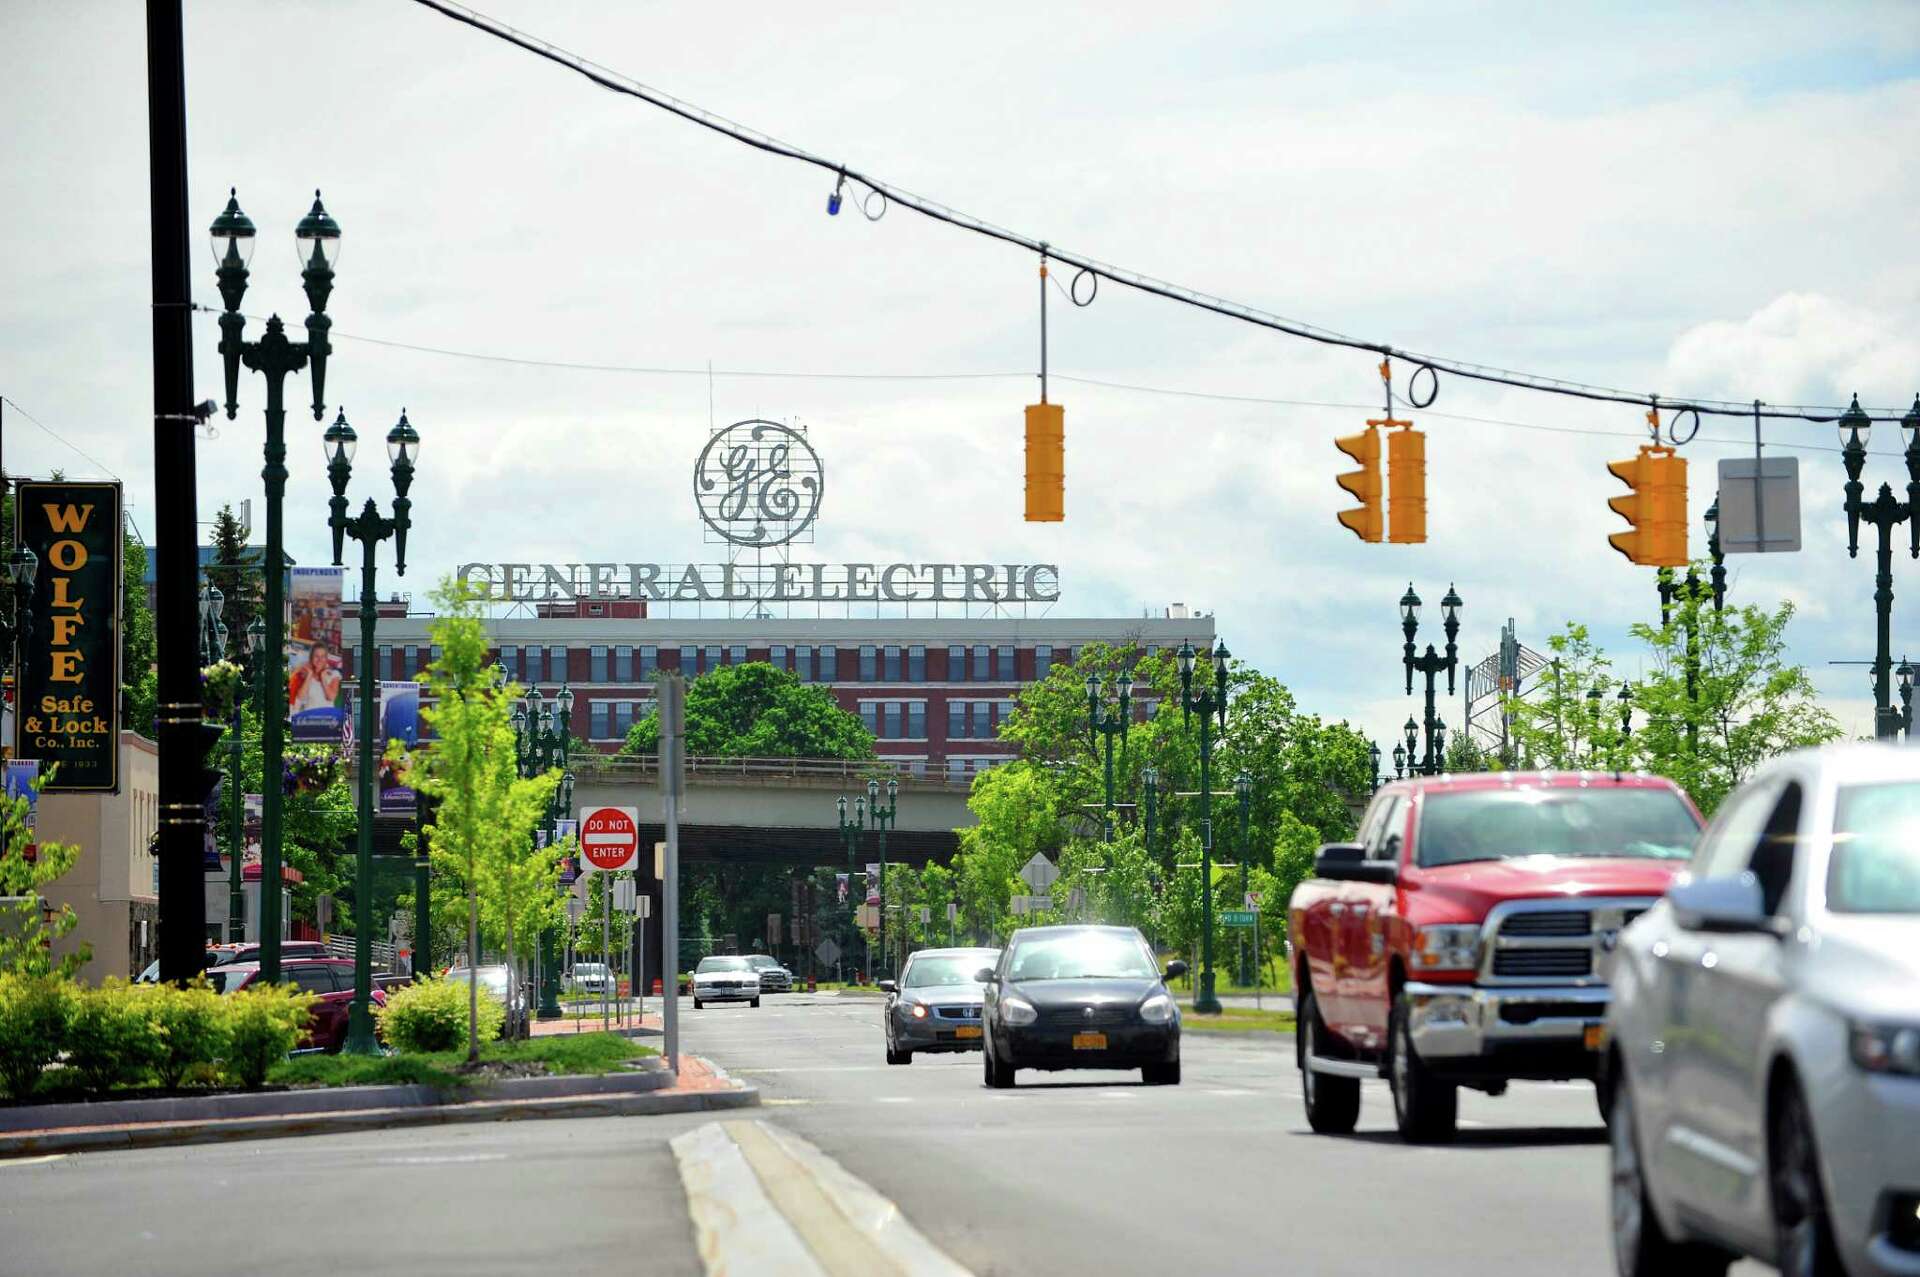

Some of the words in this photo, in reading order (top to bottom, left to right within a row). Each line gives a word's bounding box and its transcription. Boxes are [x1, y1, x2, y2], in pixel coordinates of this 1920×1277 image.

[459, 562, 750, 600] GENERAL
[770, 562, 1061, 600] ELECTRIC
[42, 503, 95, 685] WOLFE
[41, 695, 94, 713] Safe
[25, 716, 43, 733] &
[49, 716, 108, 733] Lock
[70, 736, 100, 748] Inc.
[589, 819, 604, 830] DO
[609, 819, 629, 830] NOT
[592, 847, 625, 858] ENTER
